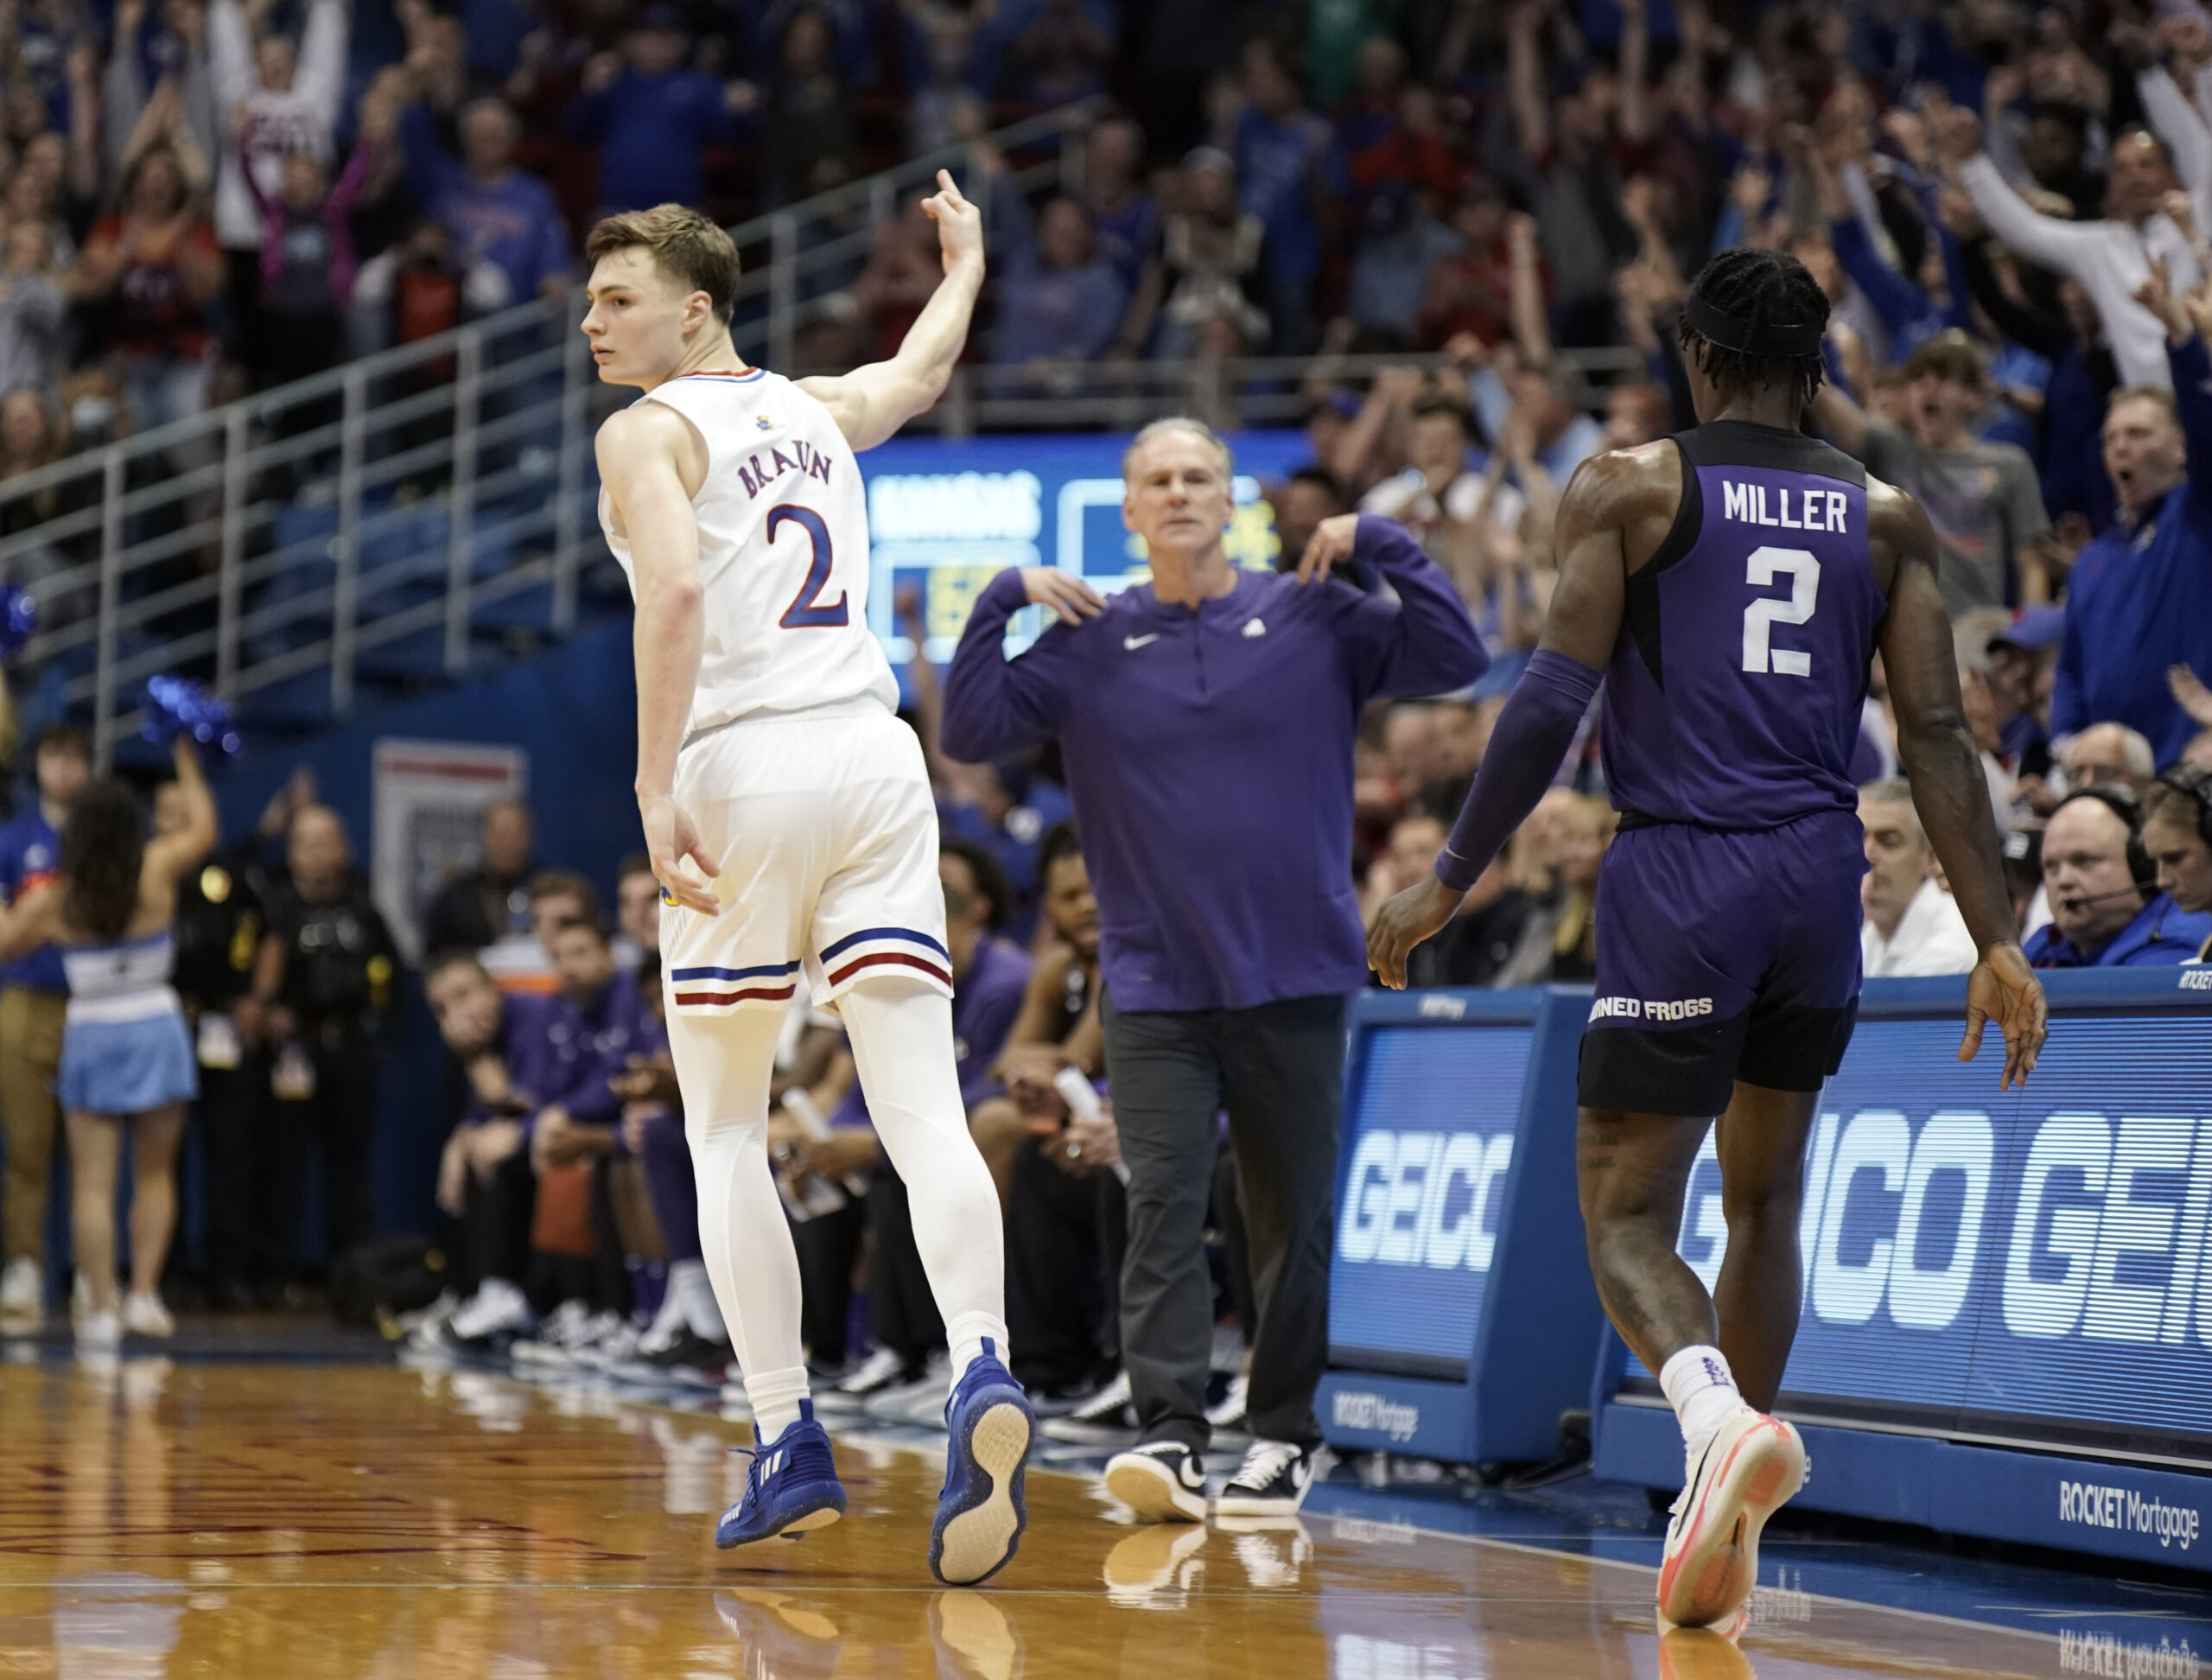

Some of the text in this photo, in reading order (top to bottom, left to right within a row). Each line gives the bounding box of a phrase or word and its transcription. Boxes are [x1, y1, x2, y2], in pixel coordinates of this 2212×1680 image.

[738, 440, 832, 500] BRAUN
[1722, 480, 1847, 534] MILLER
[766, 503, 849, 629] 2
[1742, 545, 1821, 678] 2
[1643, 997, 1713, 1021] FROGS
[2001, 1110, 2212, 1348] GEI
[2059, 1480, 2199, 1550] ROCKET Mortgage
